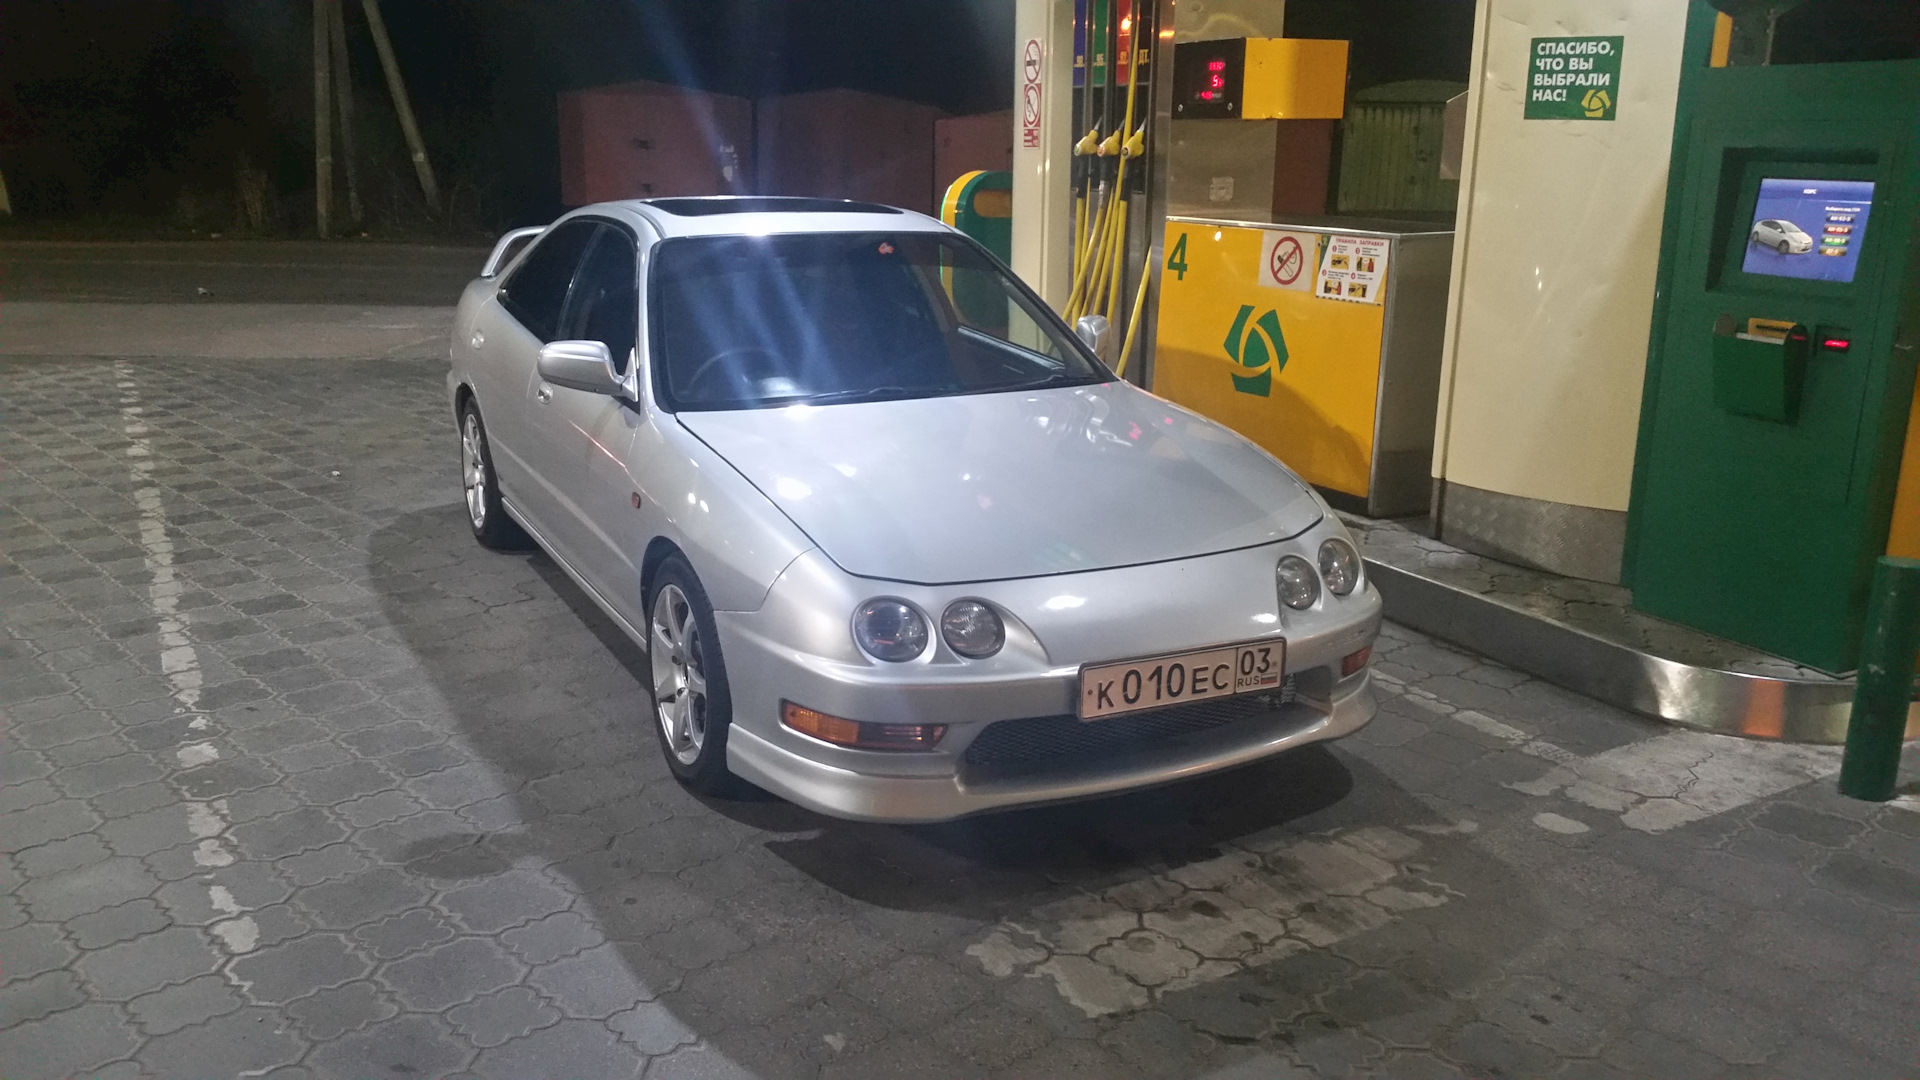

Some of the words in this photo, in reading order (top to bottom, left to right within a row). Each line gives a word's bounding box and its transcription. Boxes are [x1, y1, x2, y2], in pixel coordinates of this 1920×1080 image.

[1537, 41, 1615, 56] СПАСИБО,
[1535, 58, 1564, 71] ЧТО
[1568, 57, 1594, 70] ВЫ
[1533, 73, 1610, 86] ВЫБРАЛИ
[1532, 89, 1567, 101] НАС!
[1167, 233, 1188, 281] 4
[1240, 647, 1272, 676] 03
[1237, 675, 1260, 688] RUS
